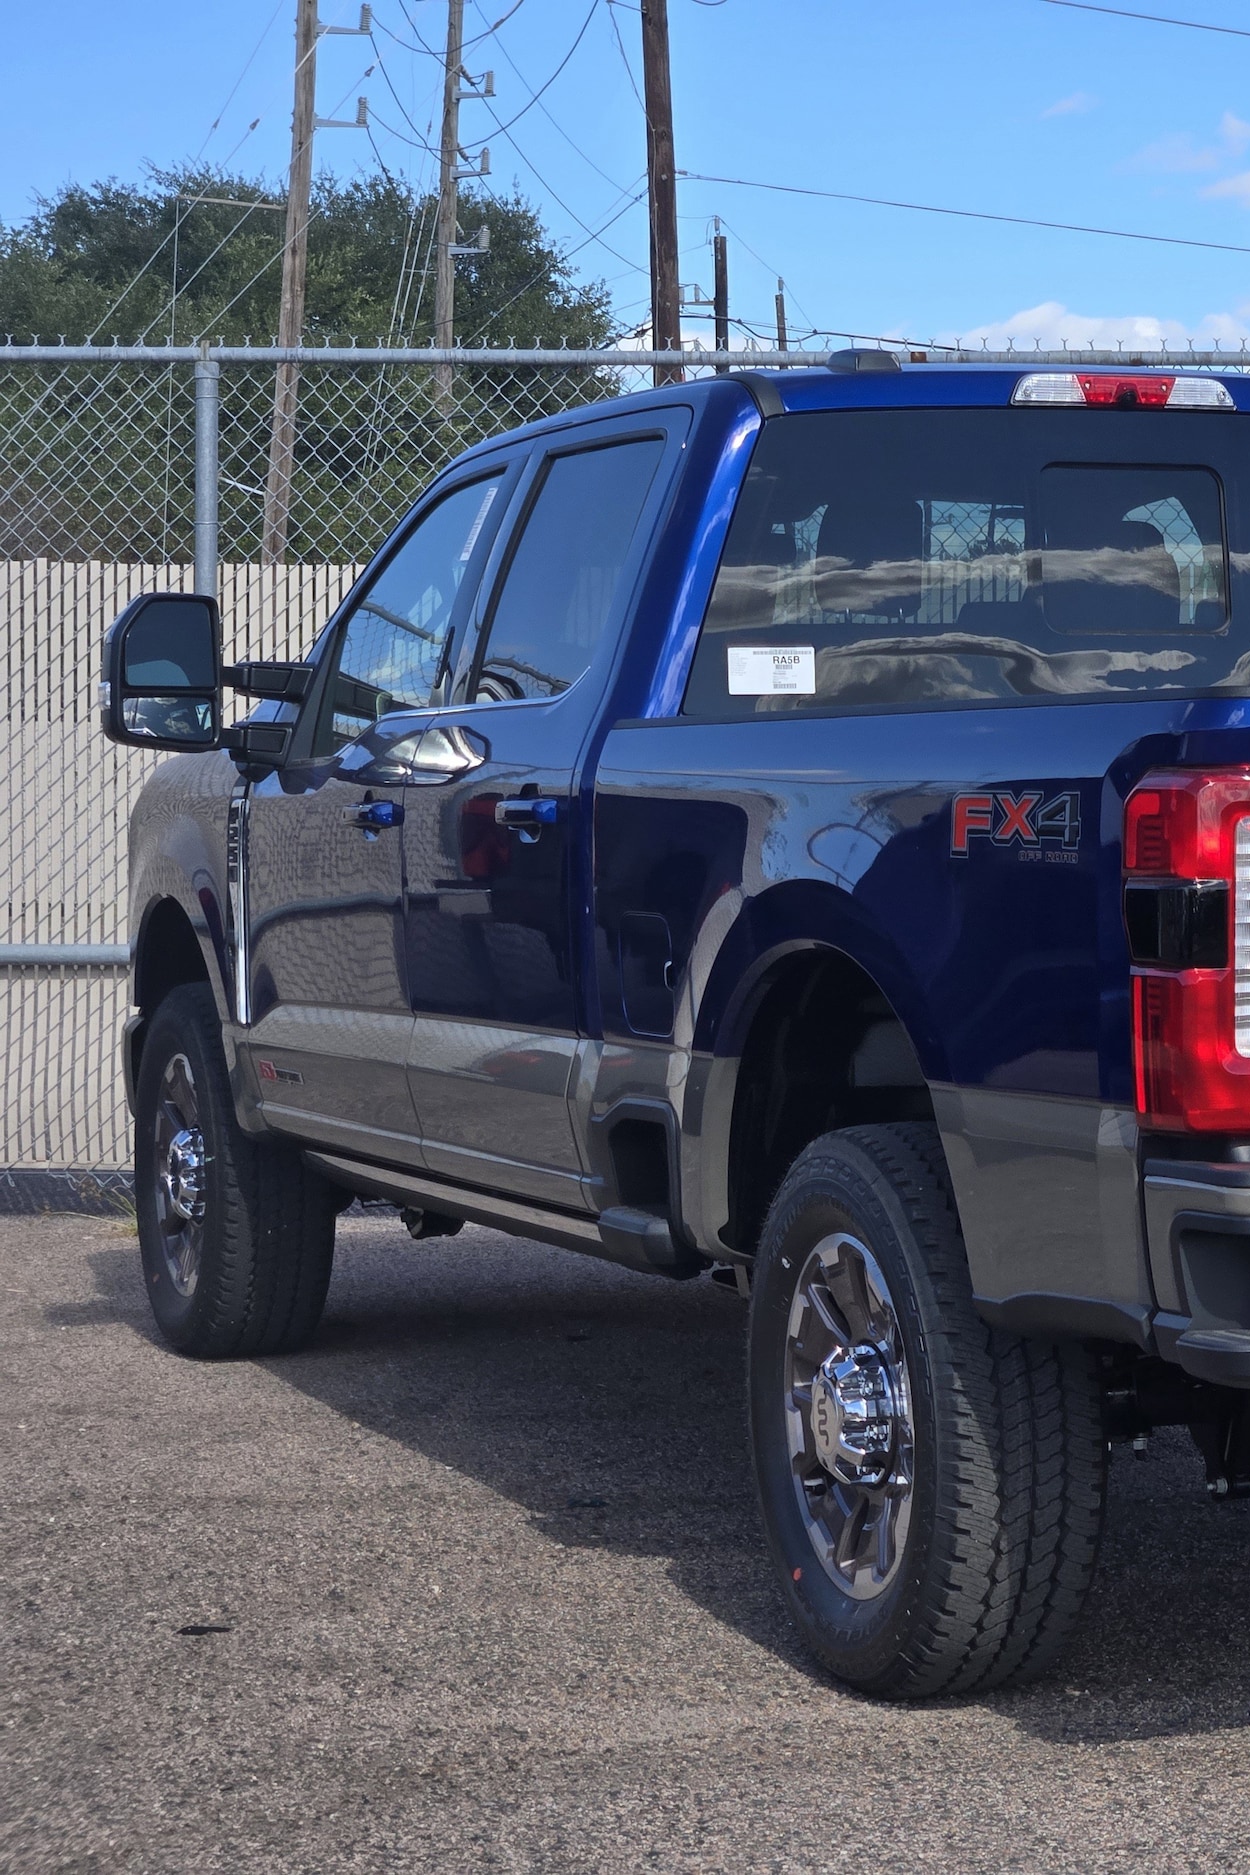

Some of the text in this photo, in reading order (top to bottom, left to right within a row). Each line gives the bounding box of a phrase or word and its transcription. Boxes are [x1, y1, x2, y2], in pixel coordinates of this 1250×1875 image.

[772, 655, 801, 664] RA5B
[950, 790, 1082, 859] FX4
[1018, 850, 1078, 864] OFF ROAD
